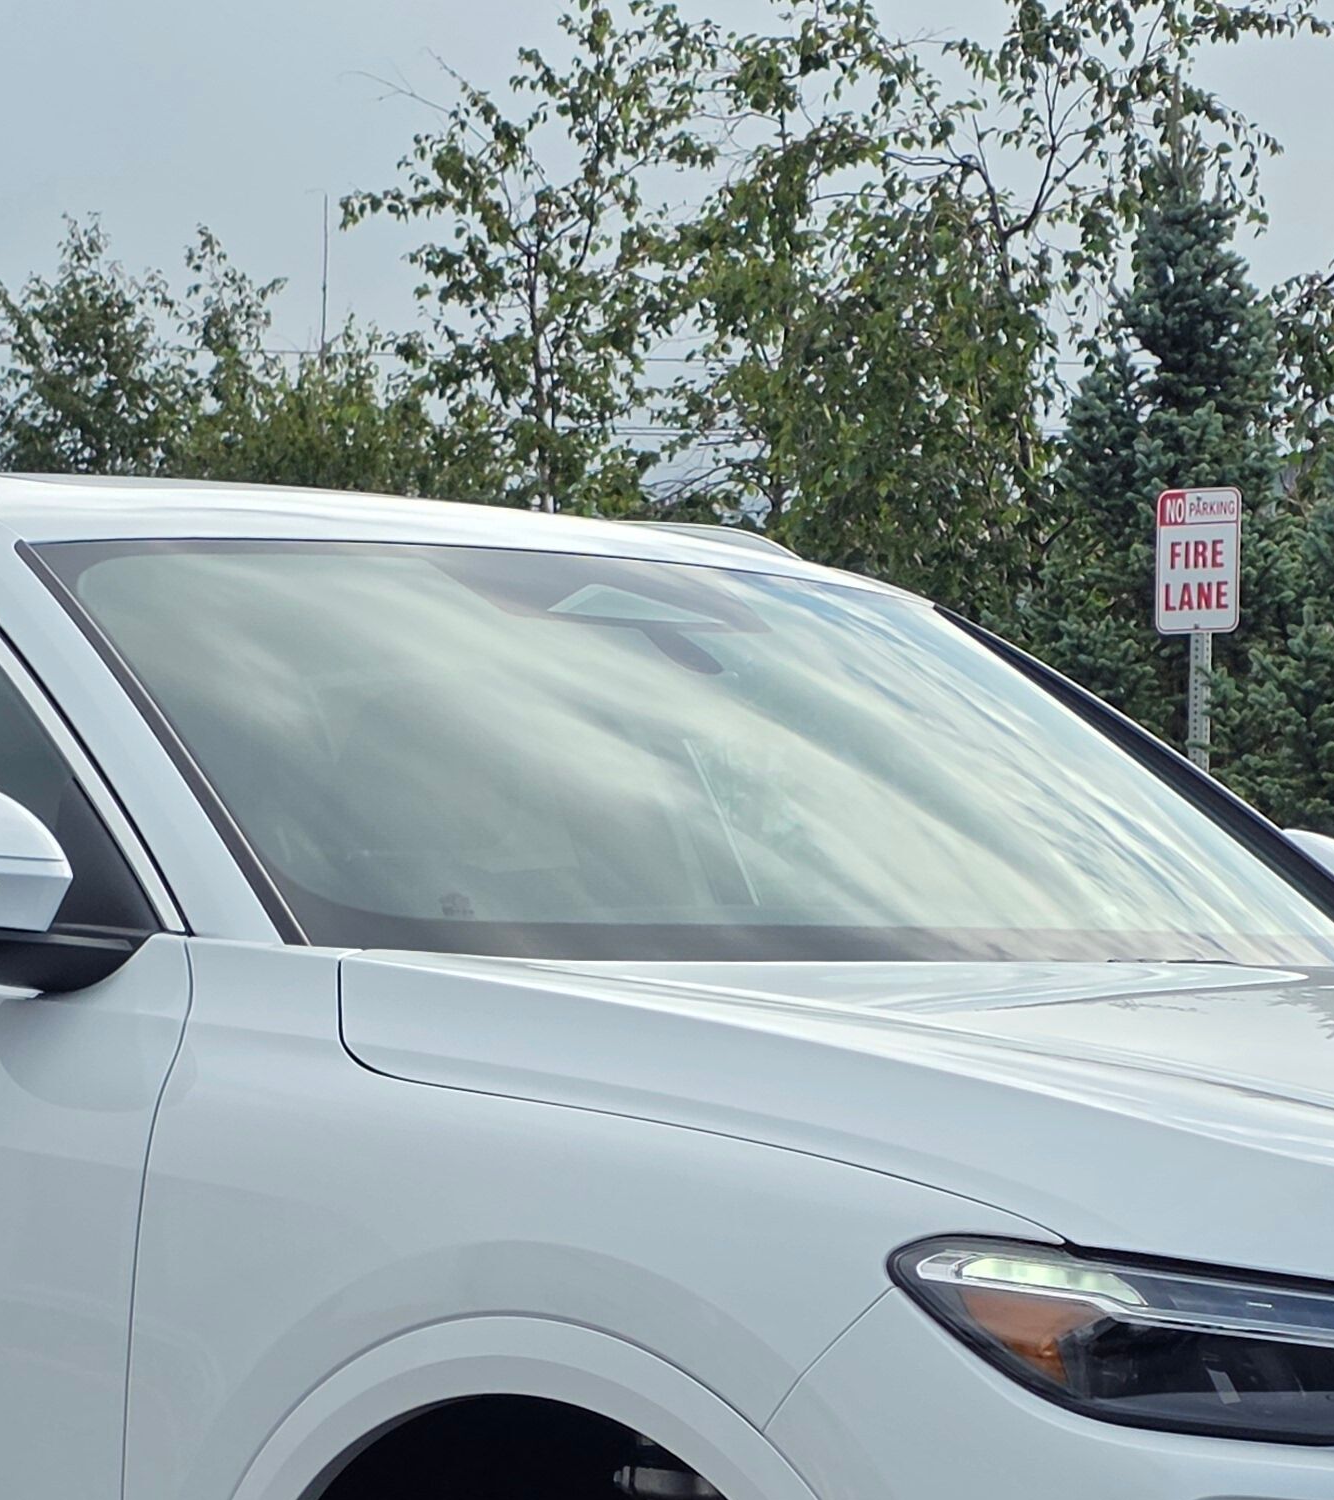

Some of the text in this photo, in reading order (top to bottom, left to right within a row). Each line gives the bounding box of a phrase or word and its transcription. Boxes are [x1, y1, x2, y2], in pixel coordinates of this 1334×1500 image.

[1166, 497, 1236, 523] NO PARKING
[1170, 539, 1225, 570] FIRE
[1164, 581, 1229, 611] LANE
